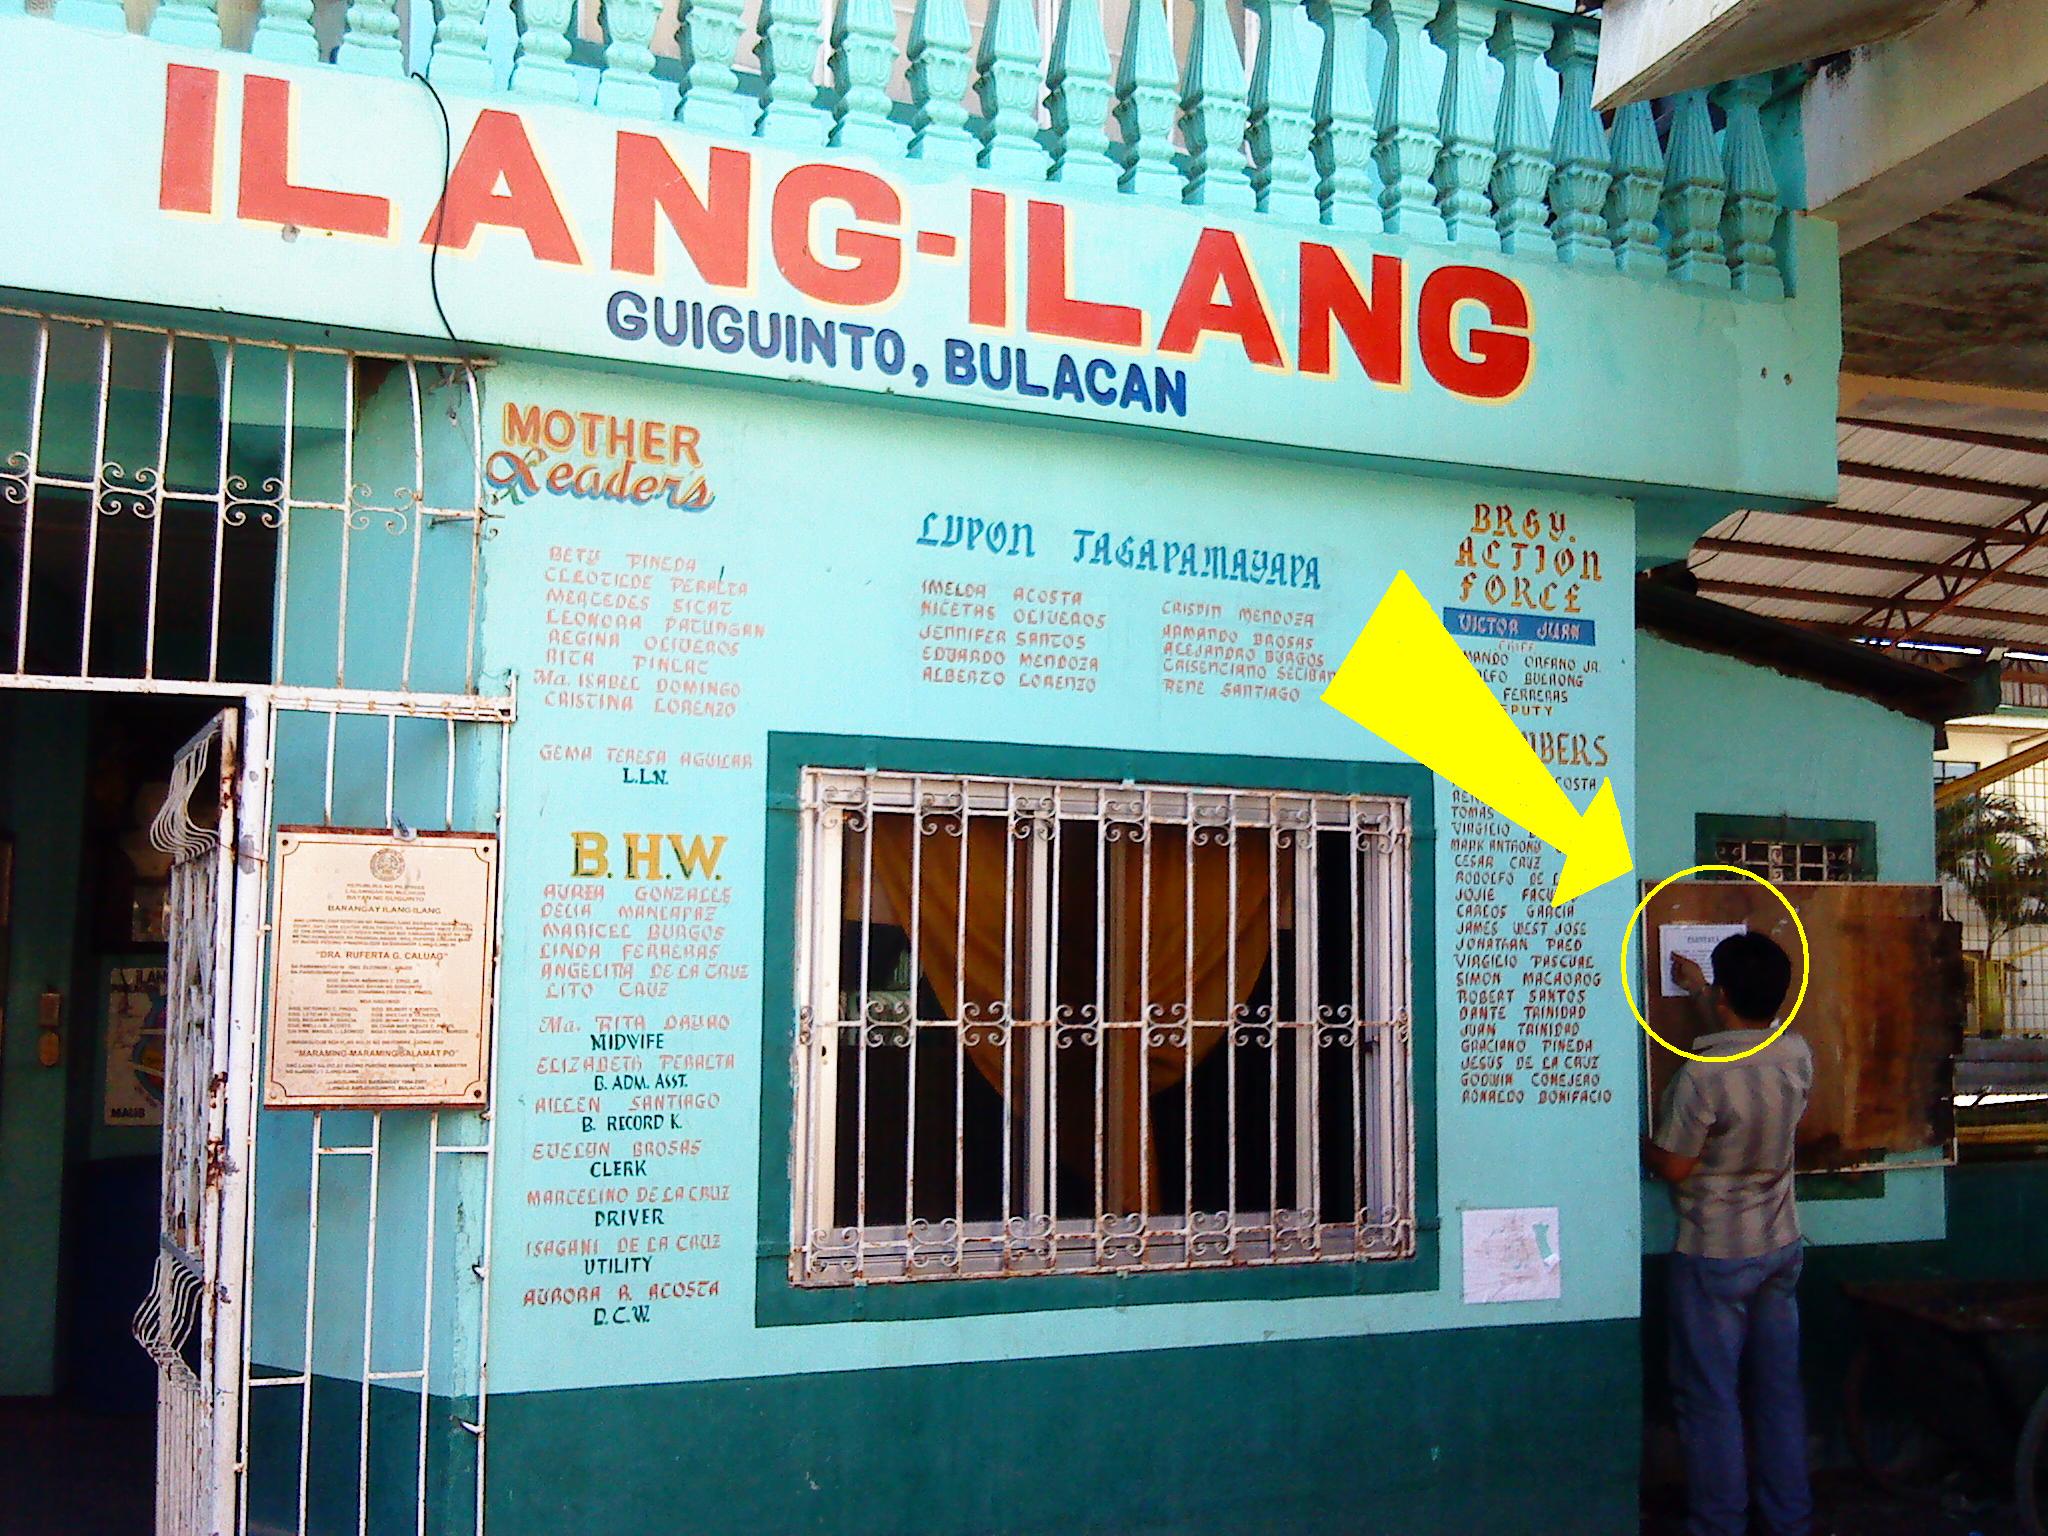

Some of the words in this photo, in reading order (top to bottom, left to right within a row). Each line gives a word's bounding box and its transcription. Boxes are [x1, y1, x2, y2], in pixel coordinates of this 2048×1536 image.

[607, 290, 929, 388] GUIGUINTO,
[945, 339, 1187, 417] BULACAN
[501, 402, 703, 469] MOTHER
[917, 512, 1035, 557] LUPON
[1072, 529, 1321, 590] TAGAPAMAYAPA
[1455, 536, 1602, 582] ACTION
[626, 553, 697, 573] PINEDA
[546, 589, 650, 611] MERCEDES
[1013, 587, 1083, 606] ACOSTA
[1459, 572, 1581, 613] FORCE
[1537, 621, 1581, 640] JUAN
[1016, 631, 1087, 649] SANTOS
[657, 678, 741, 697] DOMINGO
[1456, 922, 1498, 936] JAMES
[1456, 972, 1502, 987] SIMON
[1529, 990, 1586, 1003] SANTOS
[1459, 1006, 1506, 1020] DANTE
[1460, 1023, 1497, 1037] JUAN
[591, 1034, 664, 1050] MIDWIFE
[1542, 1040, 1593, 1052] PINEDA
[612, 1075, 649, 1090] ADM.
[655, 1074, 688, 1089] ASST.
[629, 1093, 720, 1111] SANTIAGO
[608, 1115, 664, 1131] RECORD
[590, 1160, 647, 1177] CLERK
[595, 1209, 664, 1227] DRIVER
[585, 1256, 652, 1275] UTILITY
[524, 1286, 601, 1307] AURORA
[649, 1281, 720, 1300] ACOSTA
